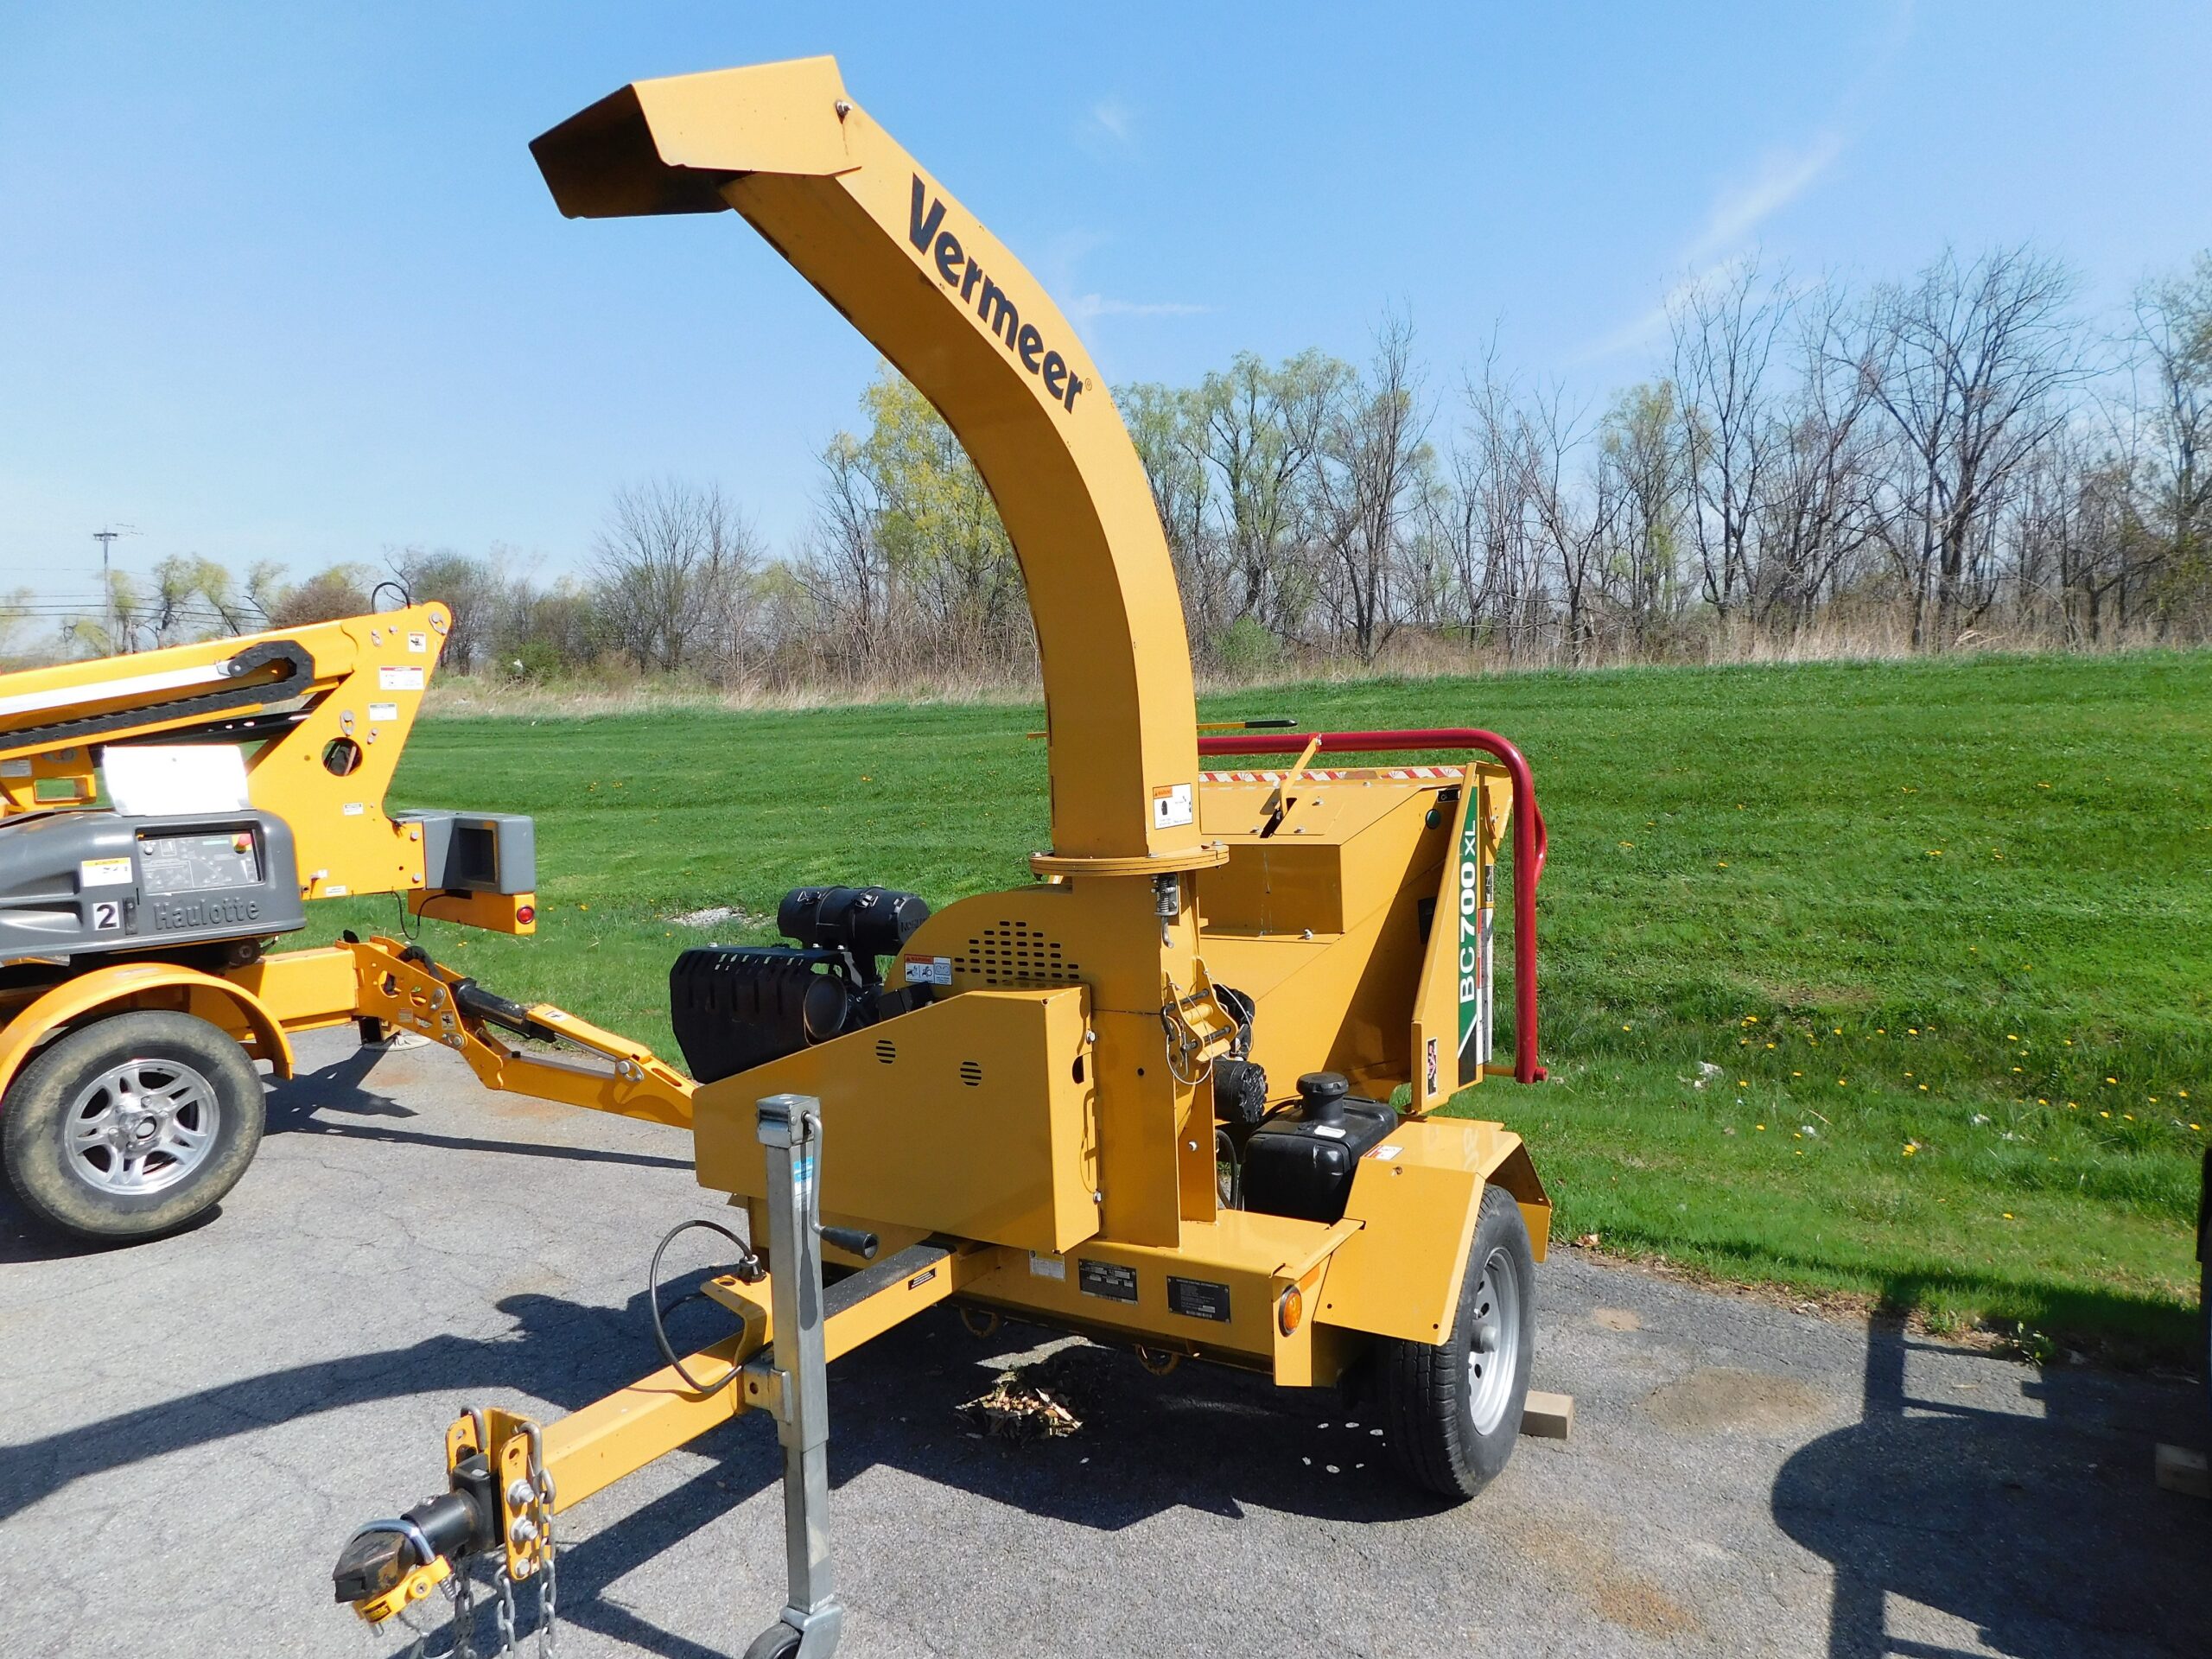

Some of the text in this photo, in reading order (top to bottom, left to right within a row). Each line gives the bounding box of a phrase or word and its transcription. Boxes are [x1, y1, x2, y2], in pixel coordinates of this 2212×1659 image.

[909, 172, 1084, 415] Vermeer
[96, 904, 118, 930] 2
[154, 897, 260, 931] Haulotte
[1459, 820, 1476, 1004] BC700 XL
